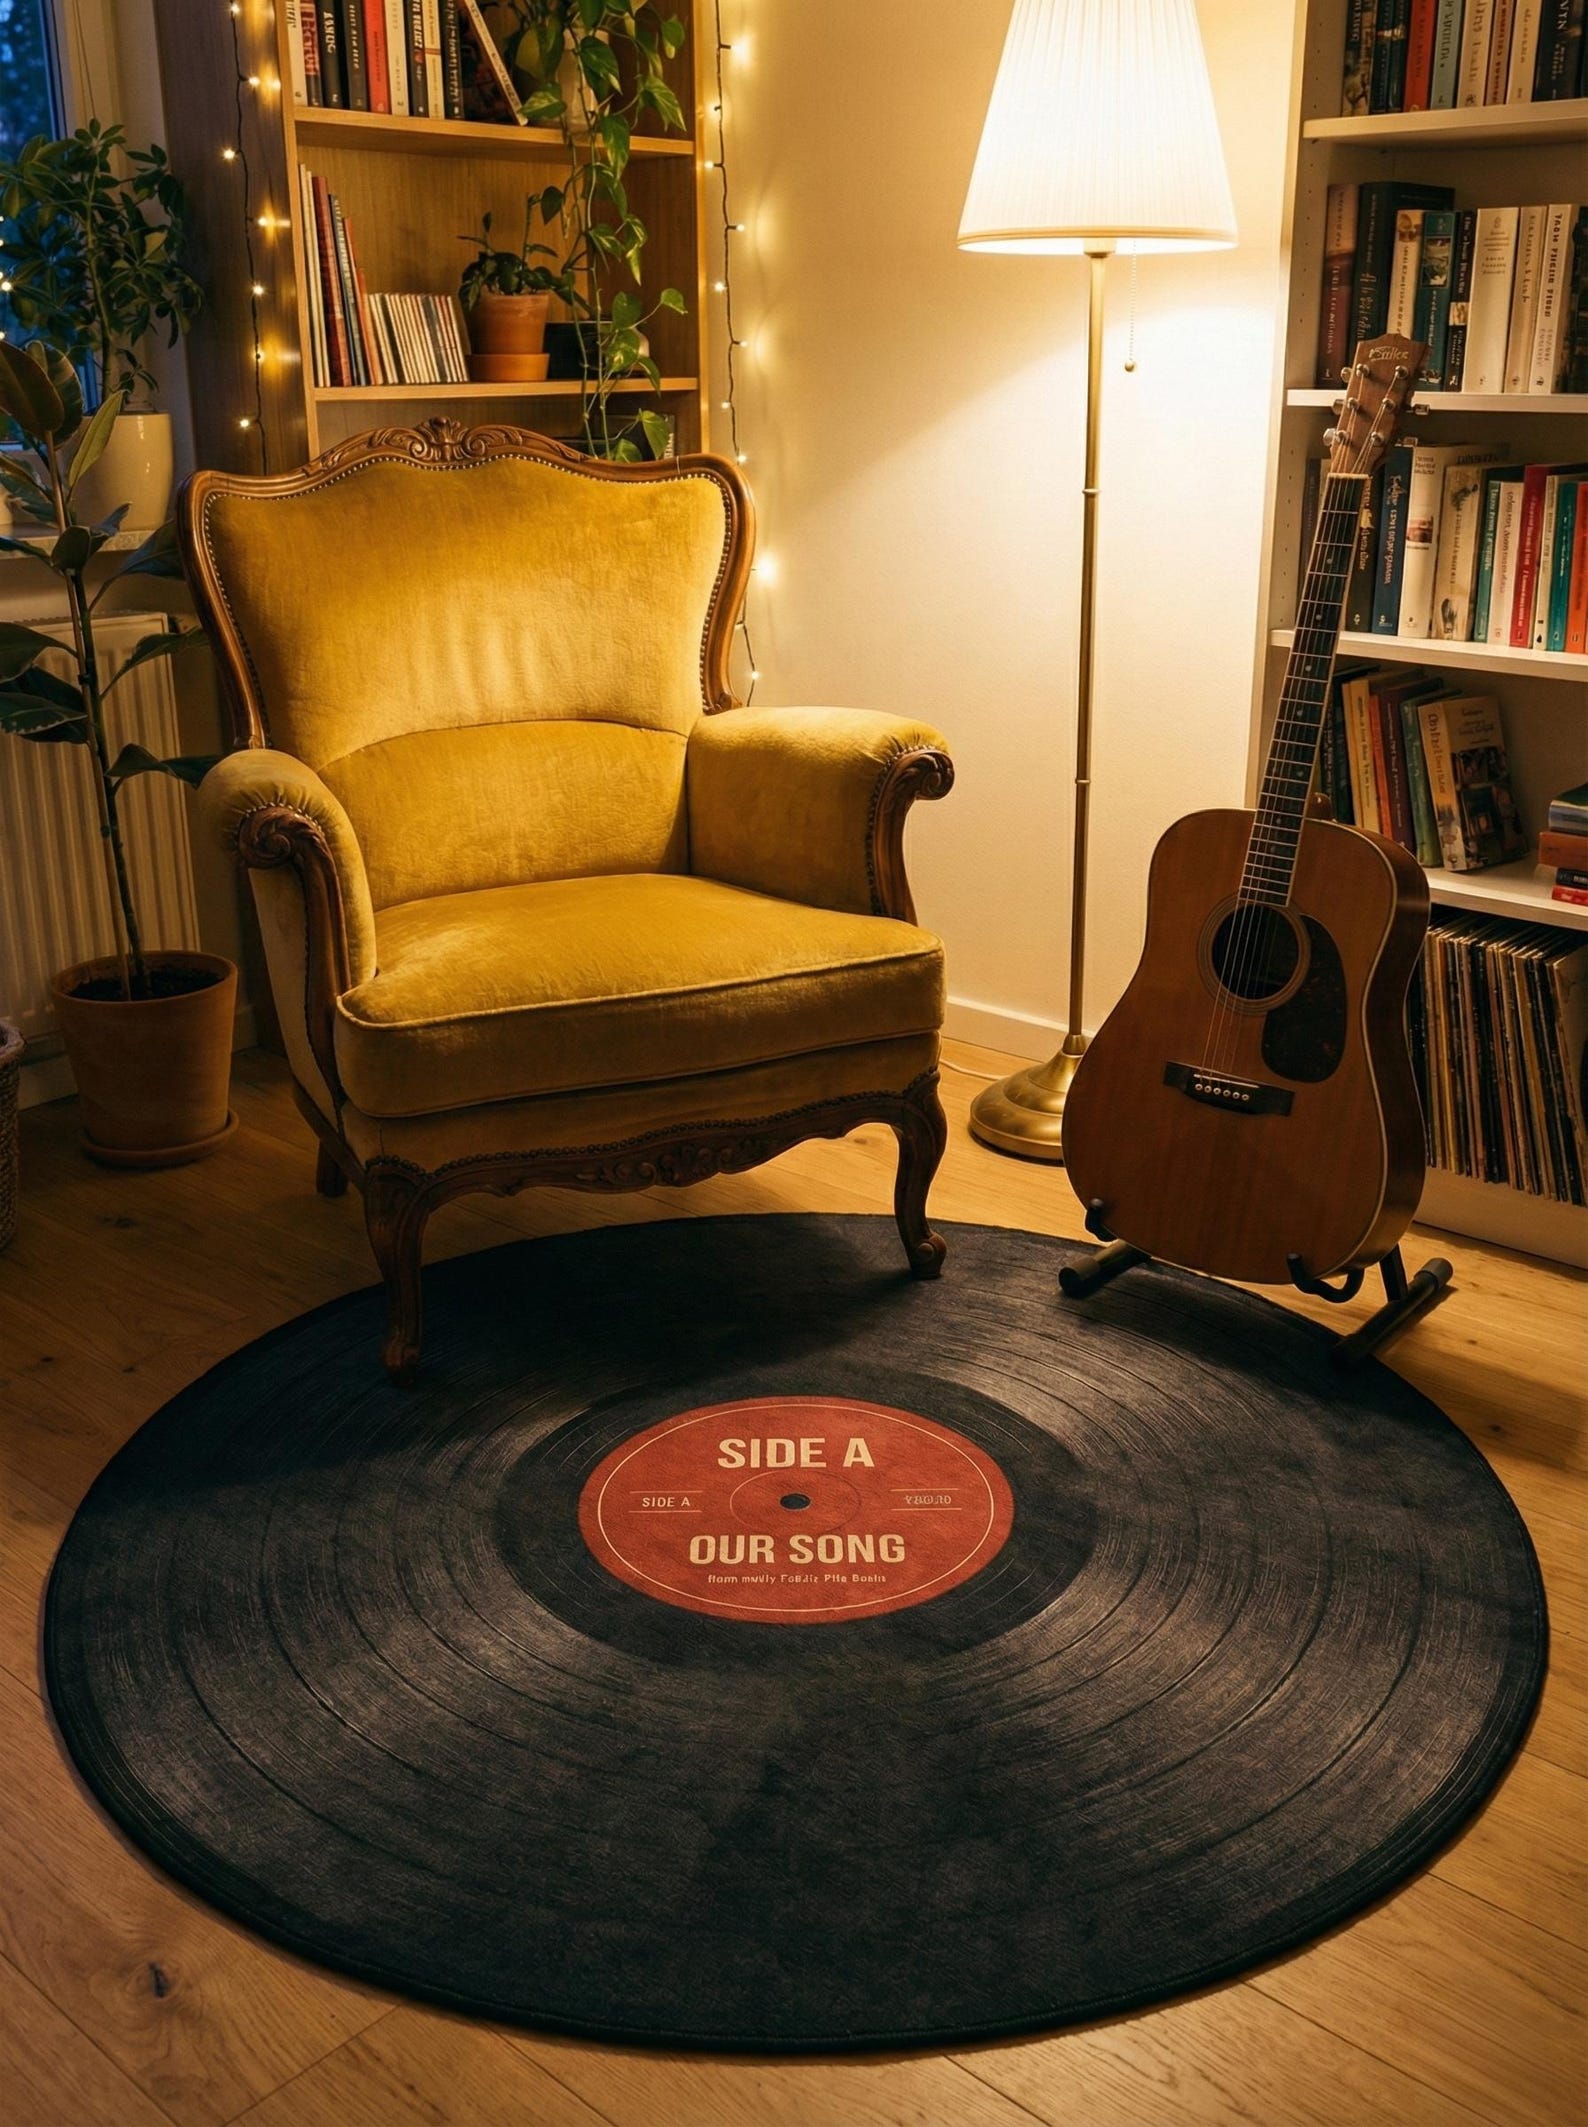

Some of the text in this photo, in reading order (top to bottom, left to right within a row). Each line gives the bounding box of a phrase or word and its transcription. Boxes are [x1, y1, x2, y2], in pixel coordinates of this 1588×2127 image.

[717, 1438, 875, 1469] SIDE A
[642, 1496, 690, 1507] SIDE A
[689, 1534, 905, 1564] OUR SONG
